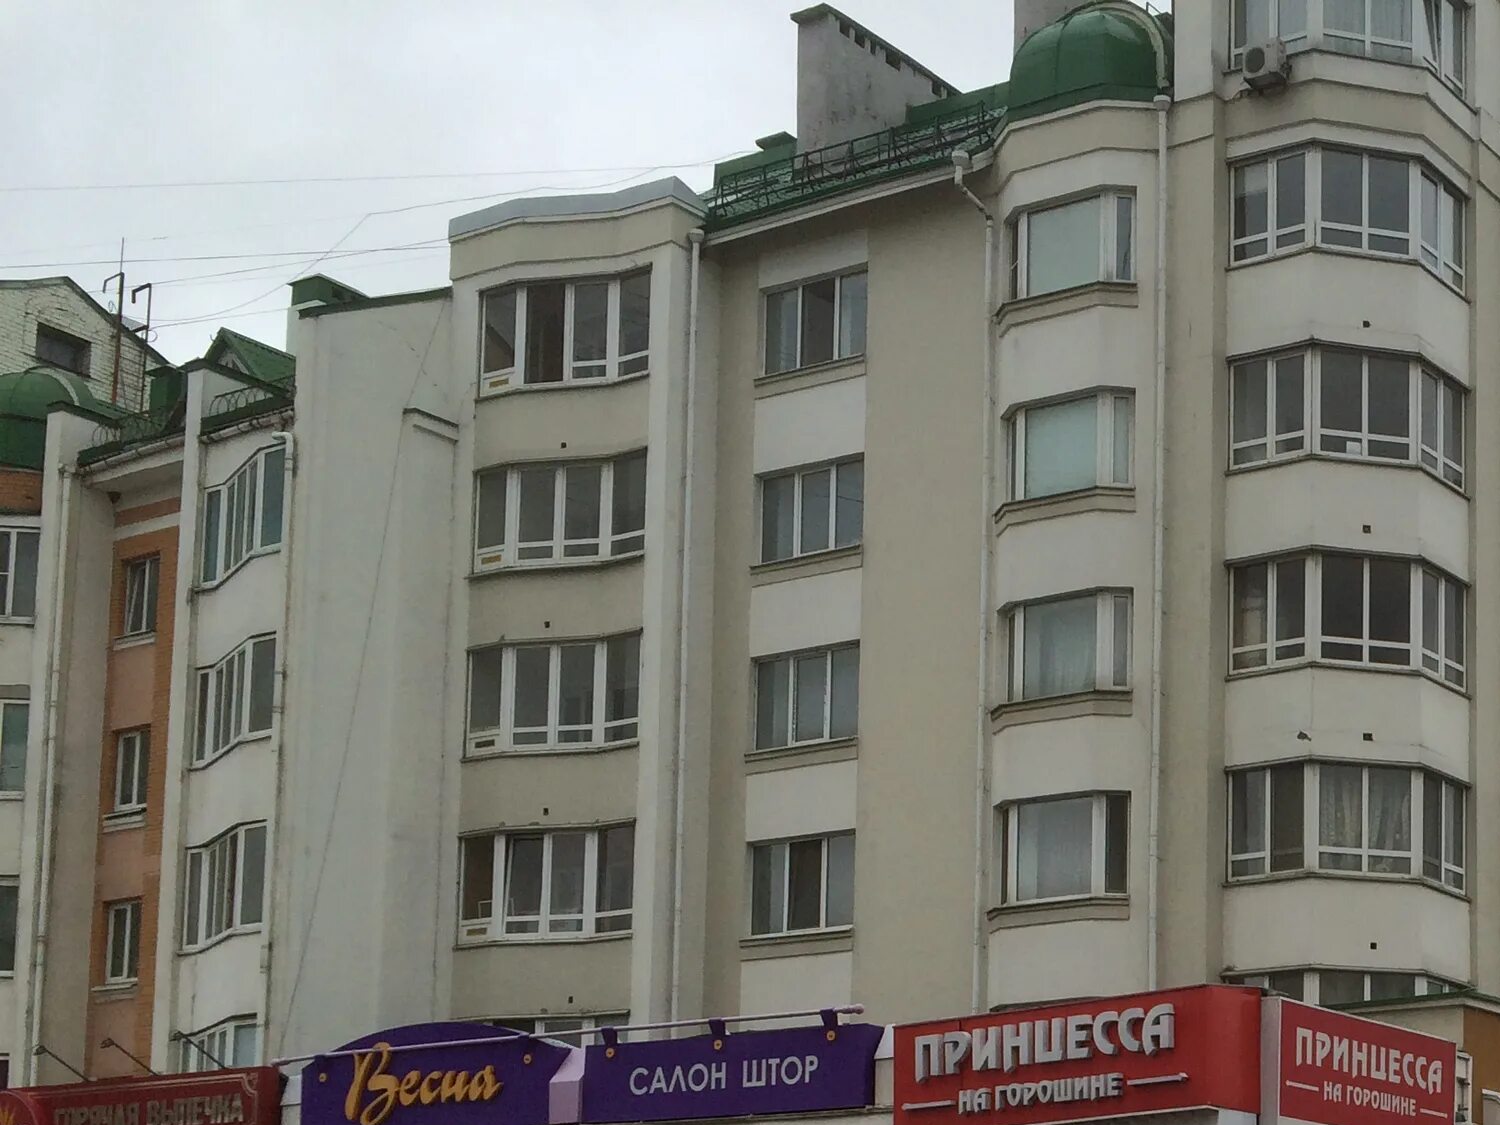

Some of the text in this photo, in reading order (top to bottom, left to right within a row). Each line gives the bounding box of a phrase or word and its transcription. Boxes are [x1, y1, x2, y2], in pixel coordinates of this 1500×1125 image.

[915, 1003, 1174, 1083] ПРИНЦЕССА
[1296, 1026, 1442, 1095] ПРИНЦЕССА
[629, 1055, 819, 1096] САЛОН ШТОР
[958, 1072, 1123, 1114] НА ГОРОШИНЕ
[1323, 1080, 1417, 1117] НА ГОРОШИНЕ
